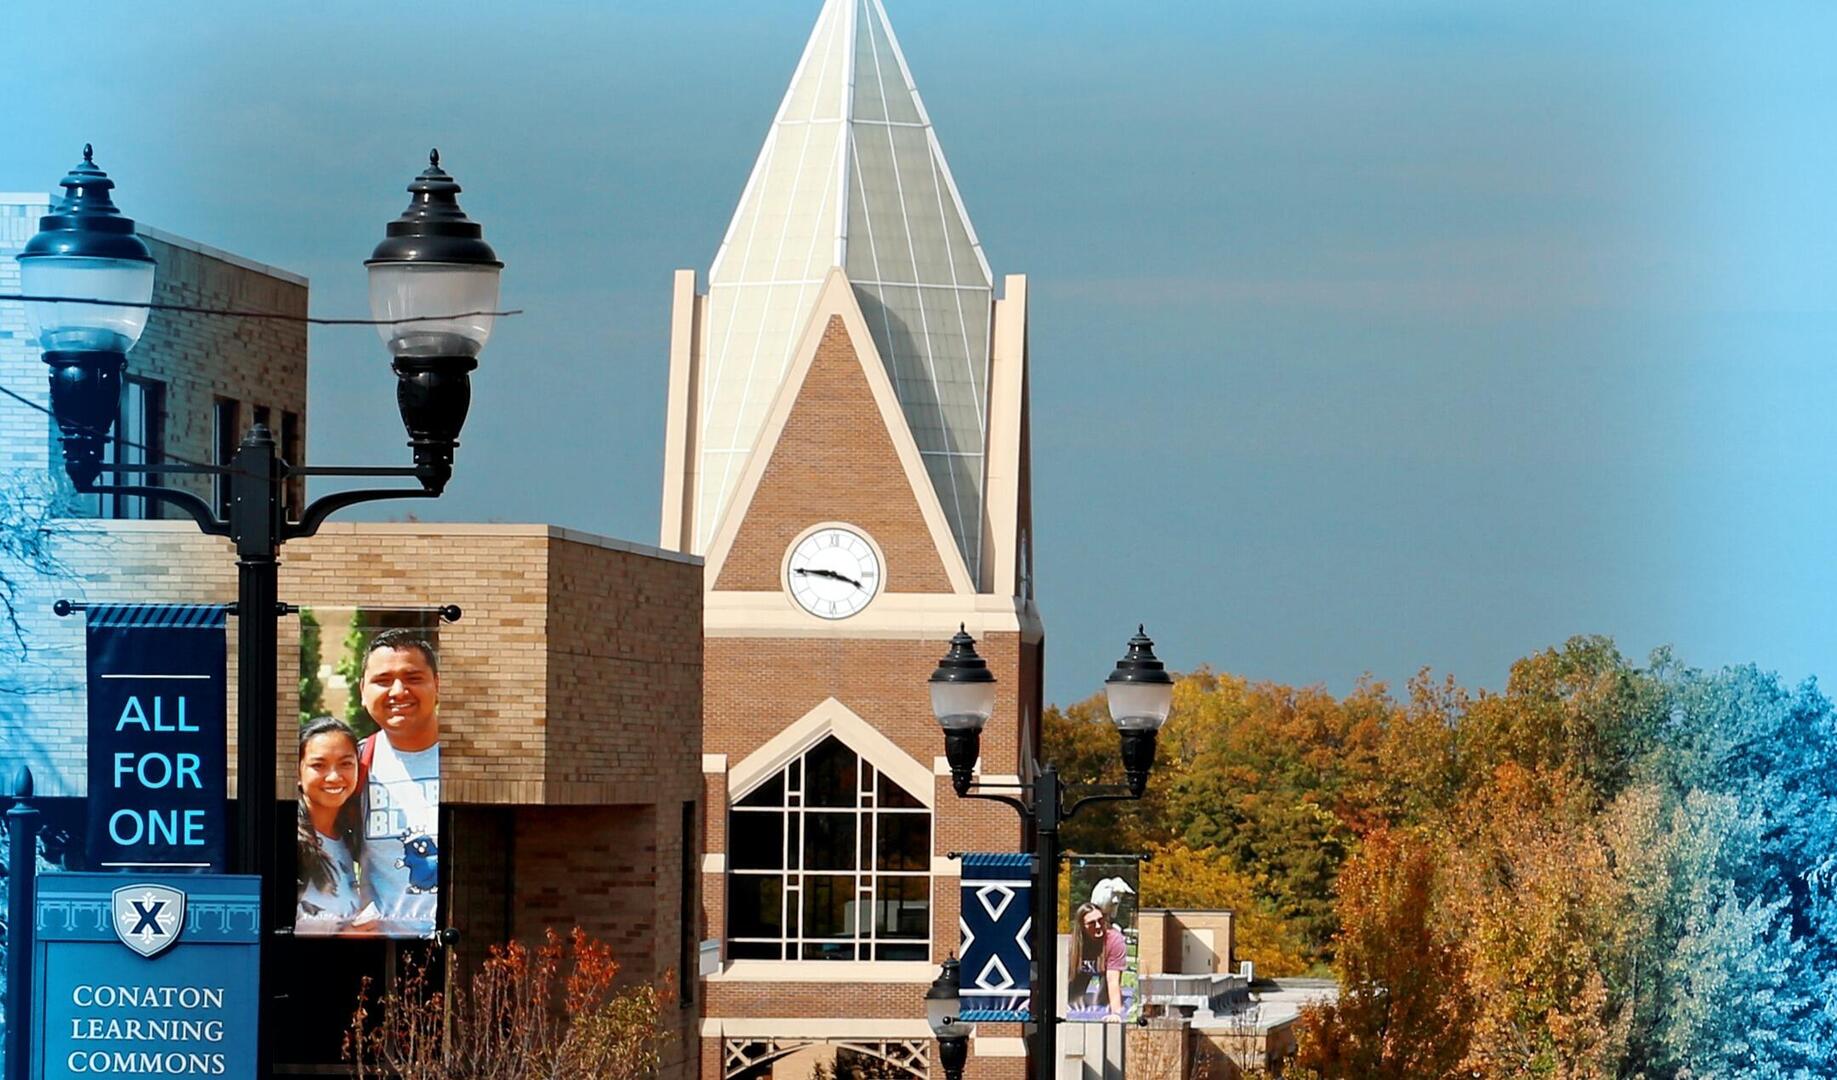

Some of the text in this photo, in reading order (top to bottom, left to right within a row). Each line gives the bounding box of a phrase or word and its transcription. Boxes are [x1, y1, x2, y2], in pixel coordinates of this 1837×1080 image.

[115, 696, 200, 731] ALL
[113, 752, 203, 789] FOR
[108, 809, 206, 846] ONE
[130, 900, 167, 935] X
[72, 985, 225, 1009] CONATON
[70, 1018, 224, 1042] LEARNING
[67, 1051, 225, 1075] COMMONS
